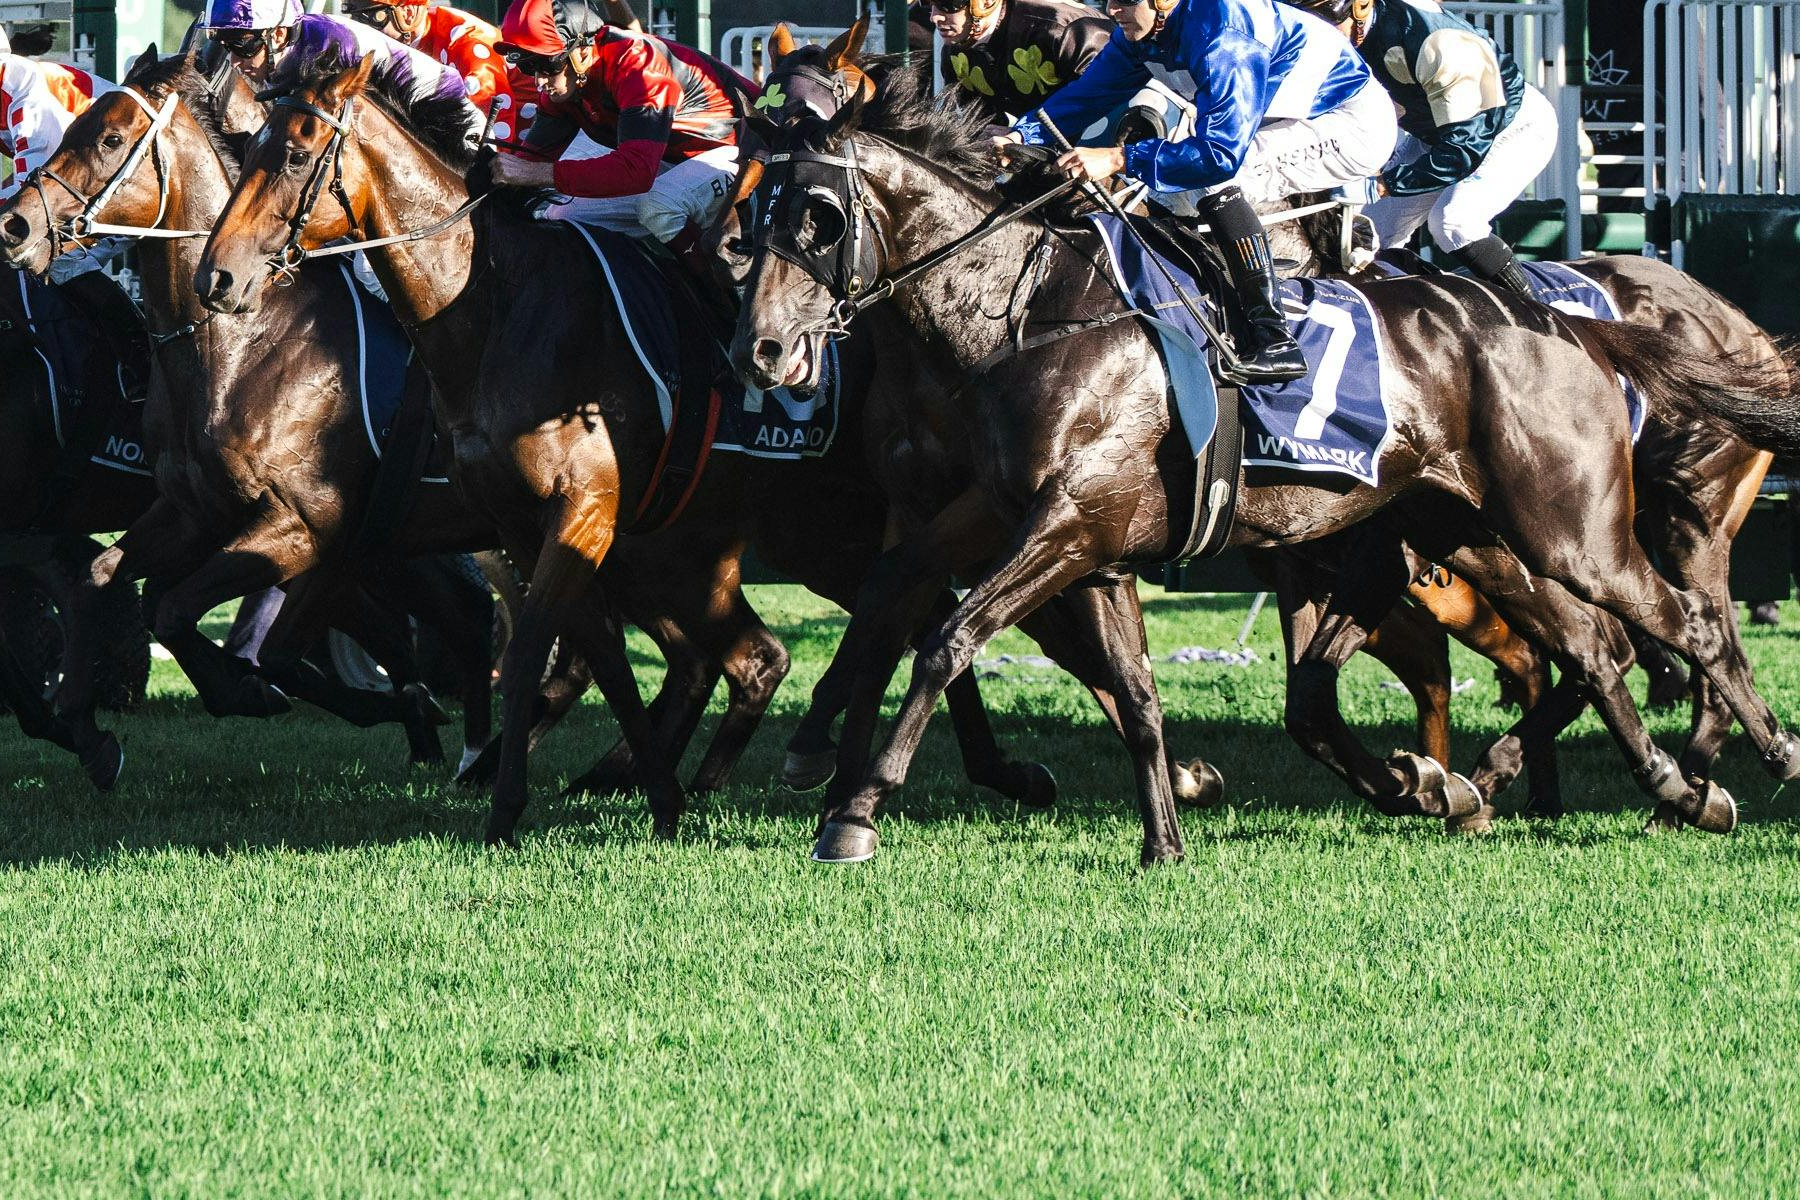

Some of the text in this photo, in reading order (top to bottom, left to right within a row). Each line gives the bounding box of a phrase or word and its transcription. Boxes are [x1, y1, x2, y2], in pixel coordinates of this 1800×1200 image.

[1280, 297, 1357, 441] 7
[754, 424, 825, 449] ADAO
[1257, 432, 1368, 476] WYMARK
